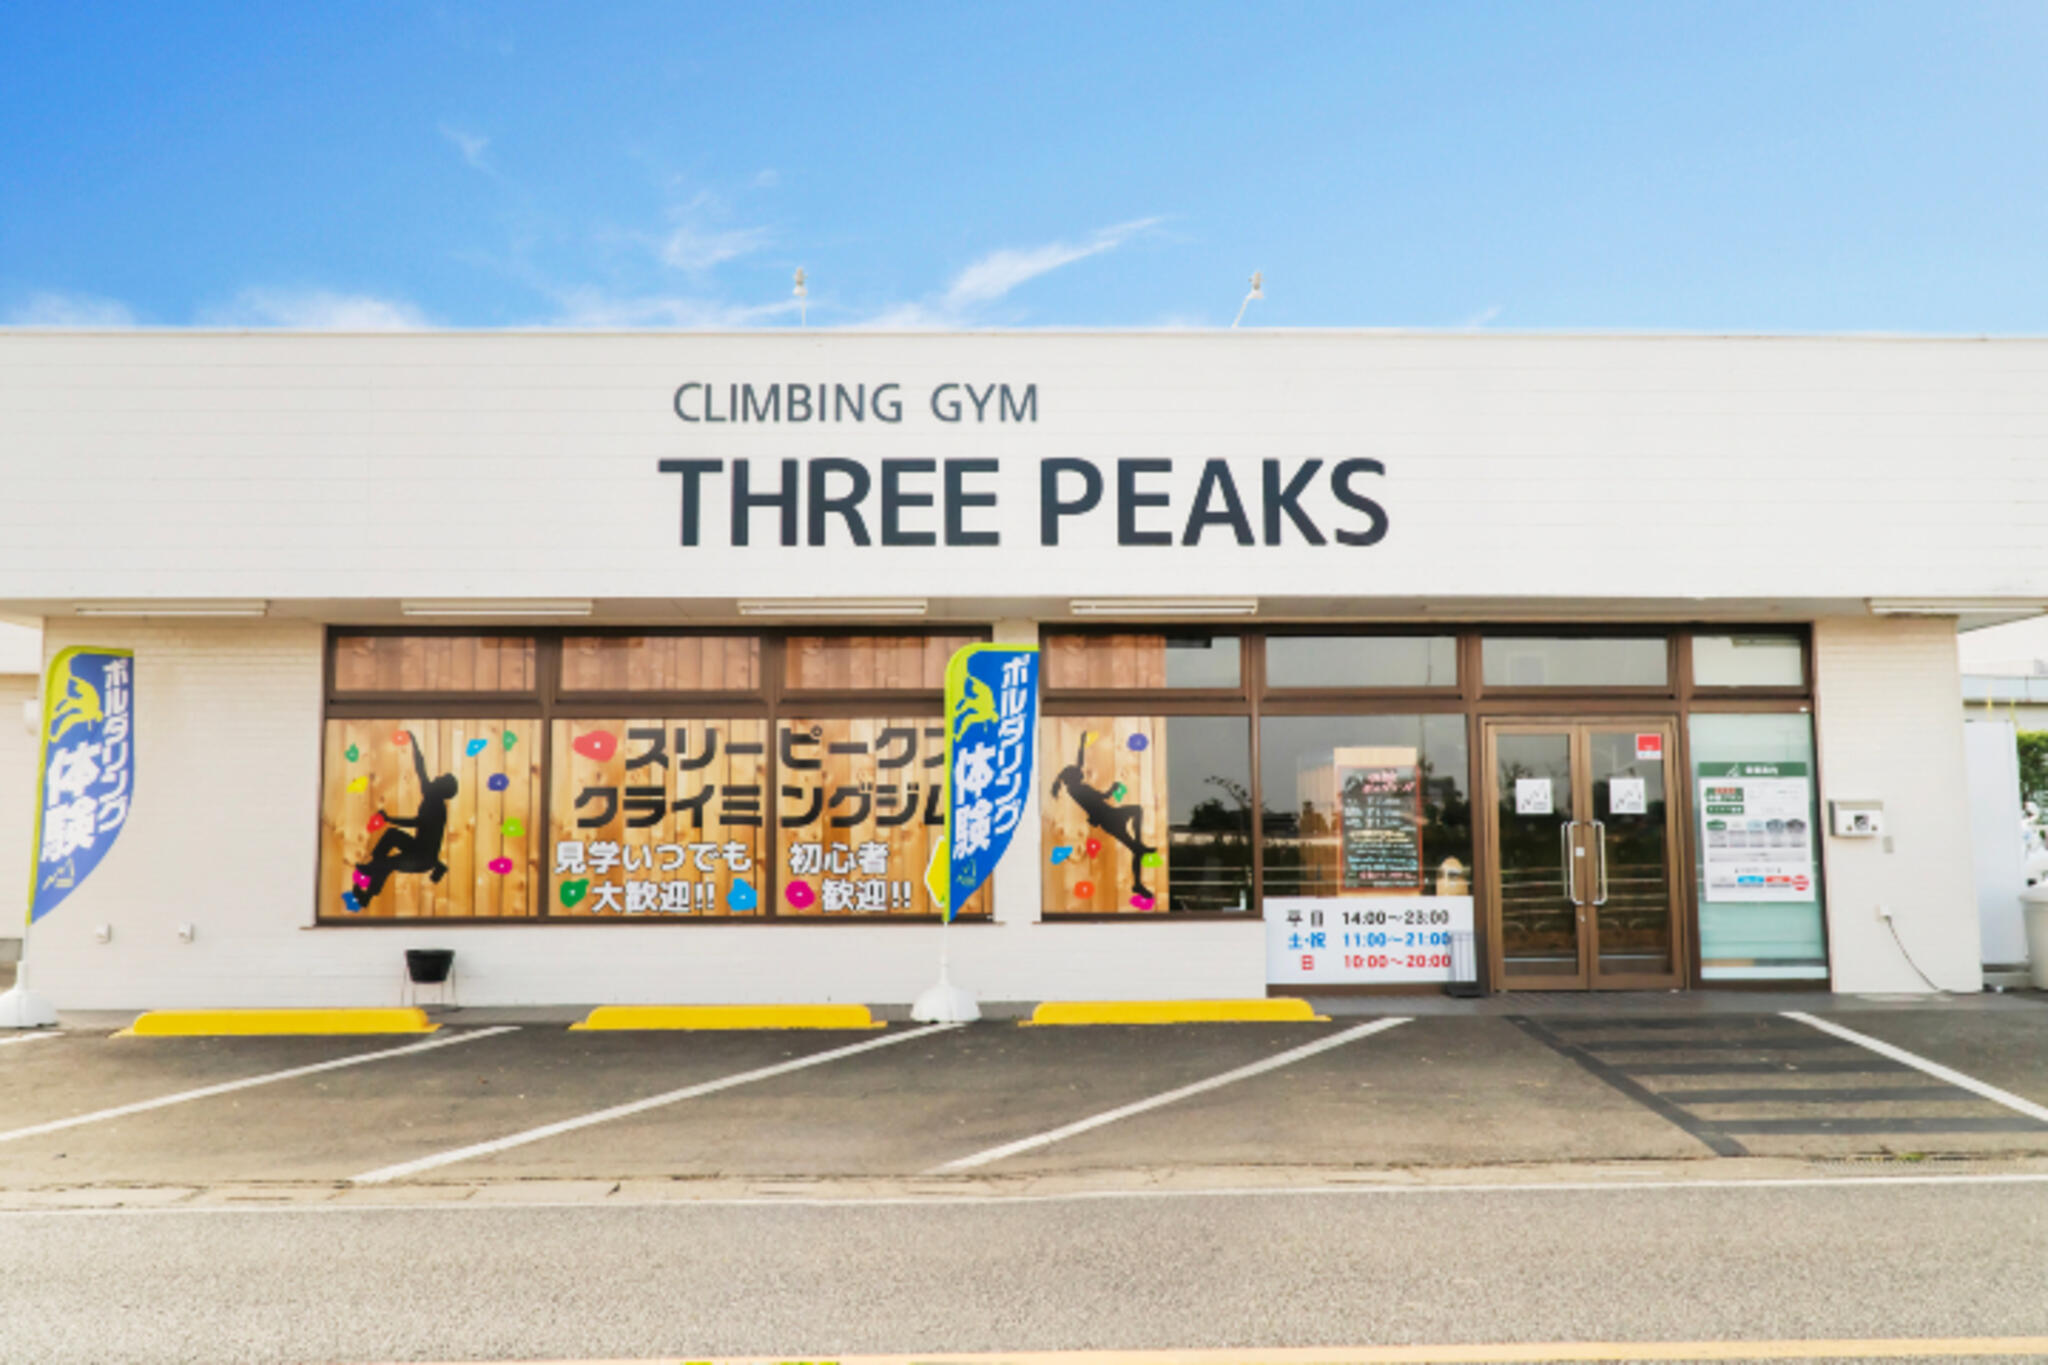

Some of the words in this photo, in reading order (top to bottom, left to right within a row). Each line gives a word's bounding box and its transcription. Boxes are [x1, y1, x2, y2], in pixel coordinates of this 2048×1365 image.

[672, 383, 904, 423] CLIMBING
[930, 383, 1040, 423] GYM
[657, 457, 1001, 547] THREE
[1040, 457, 1390, 547] PEAKS
[40, 740, 101, 863] 体験
[952, 741, 996, 860] 体験
[553, 840, 752, 875] 見学いつでも
[789, 841, 889, 875] 初心者
[1301, 954, 1315, 972] 日
